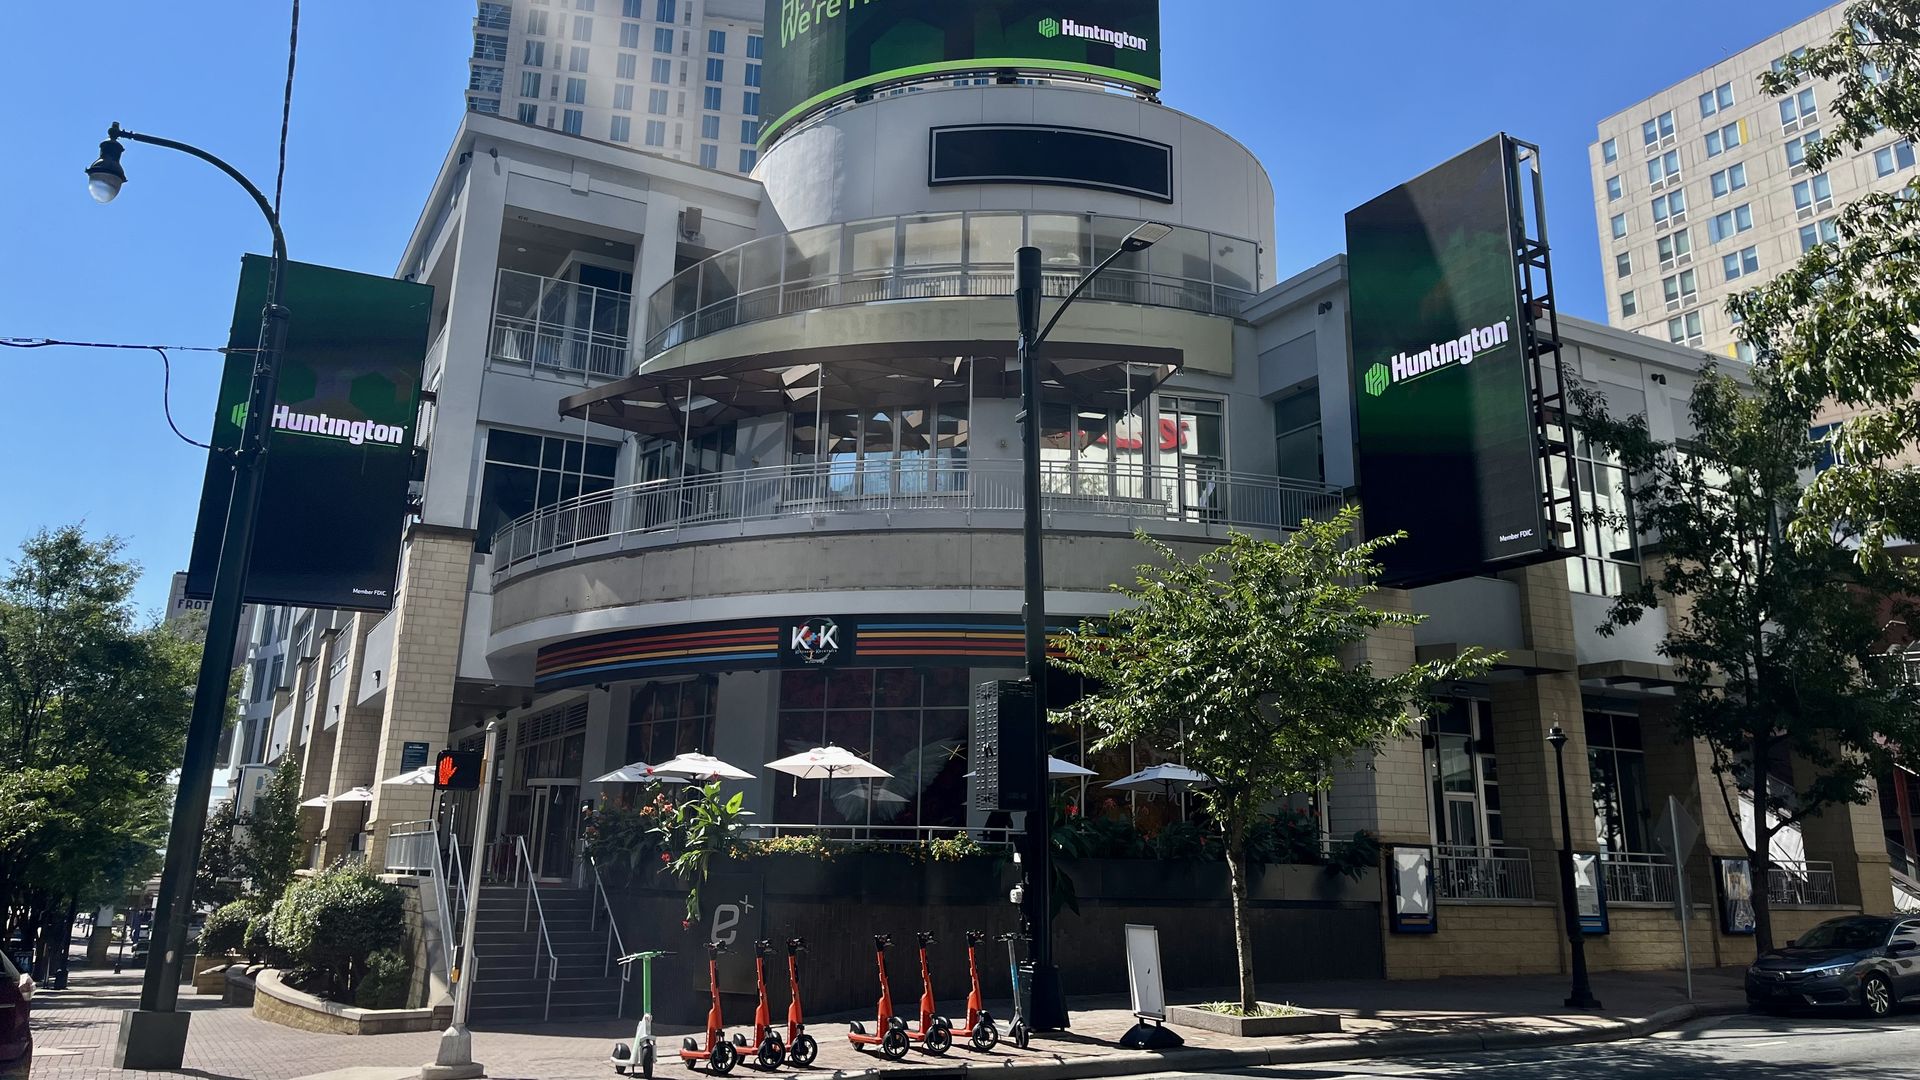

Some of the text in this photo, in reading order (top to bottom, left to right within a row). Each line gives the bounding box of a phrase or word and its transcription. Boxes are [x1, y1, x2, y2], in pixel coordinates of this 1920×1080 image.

[1062, 19, 1146, 51] Huntington
[1391, 321, 1508, 382] Huntington
[271, 404, 403, 445] Huntington
